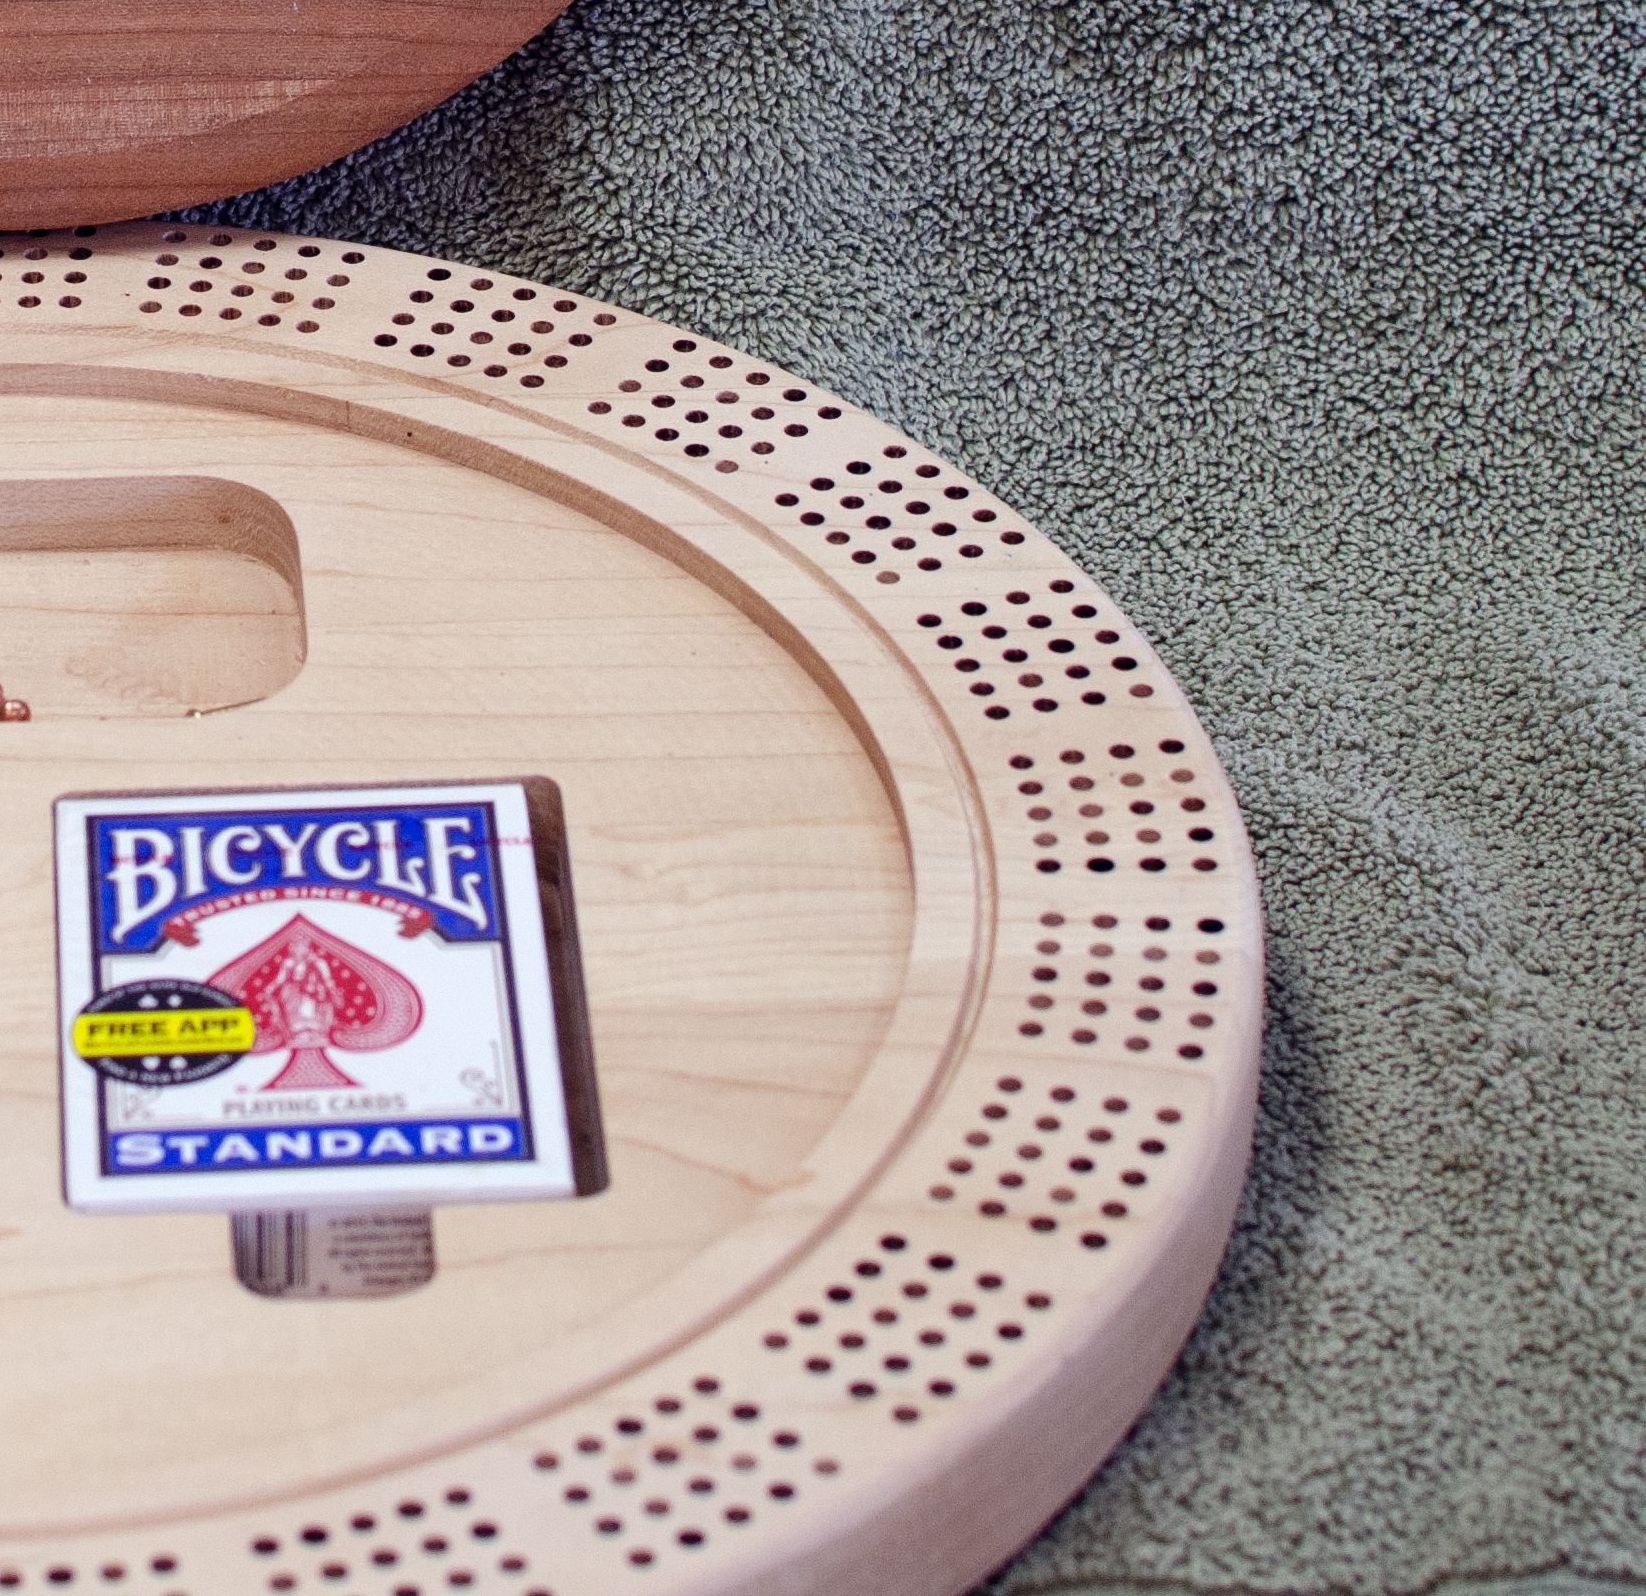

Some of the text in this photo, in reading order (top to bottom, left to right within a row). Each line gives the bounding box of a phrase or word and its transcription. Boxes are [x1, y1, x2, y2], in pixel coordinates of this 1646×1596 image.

[107, 817, 488, 942] BICYCLE
[170, 887, 277, 926] TRUSTED
[282, 885, 362, 901] SINCE
[88, 1017, 240, 1037] FREE APP
[222, 1094, 407, 1120] PLAYING CARDS
[115, 1125, 515, 1167] STANDARD
